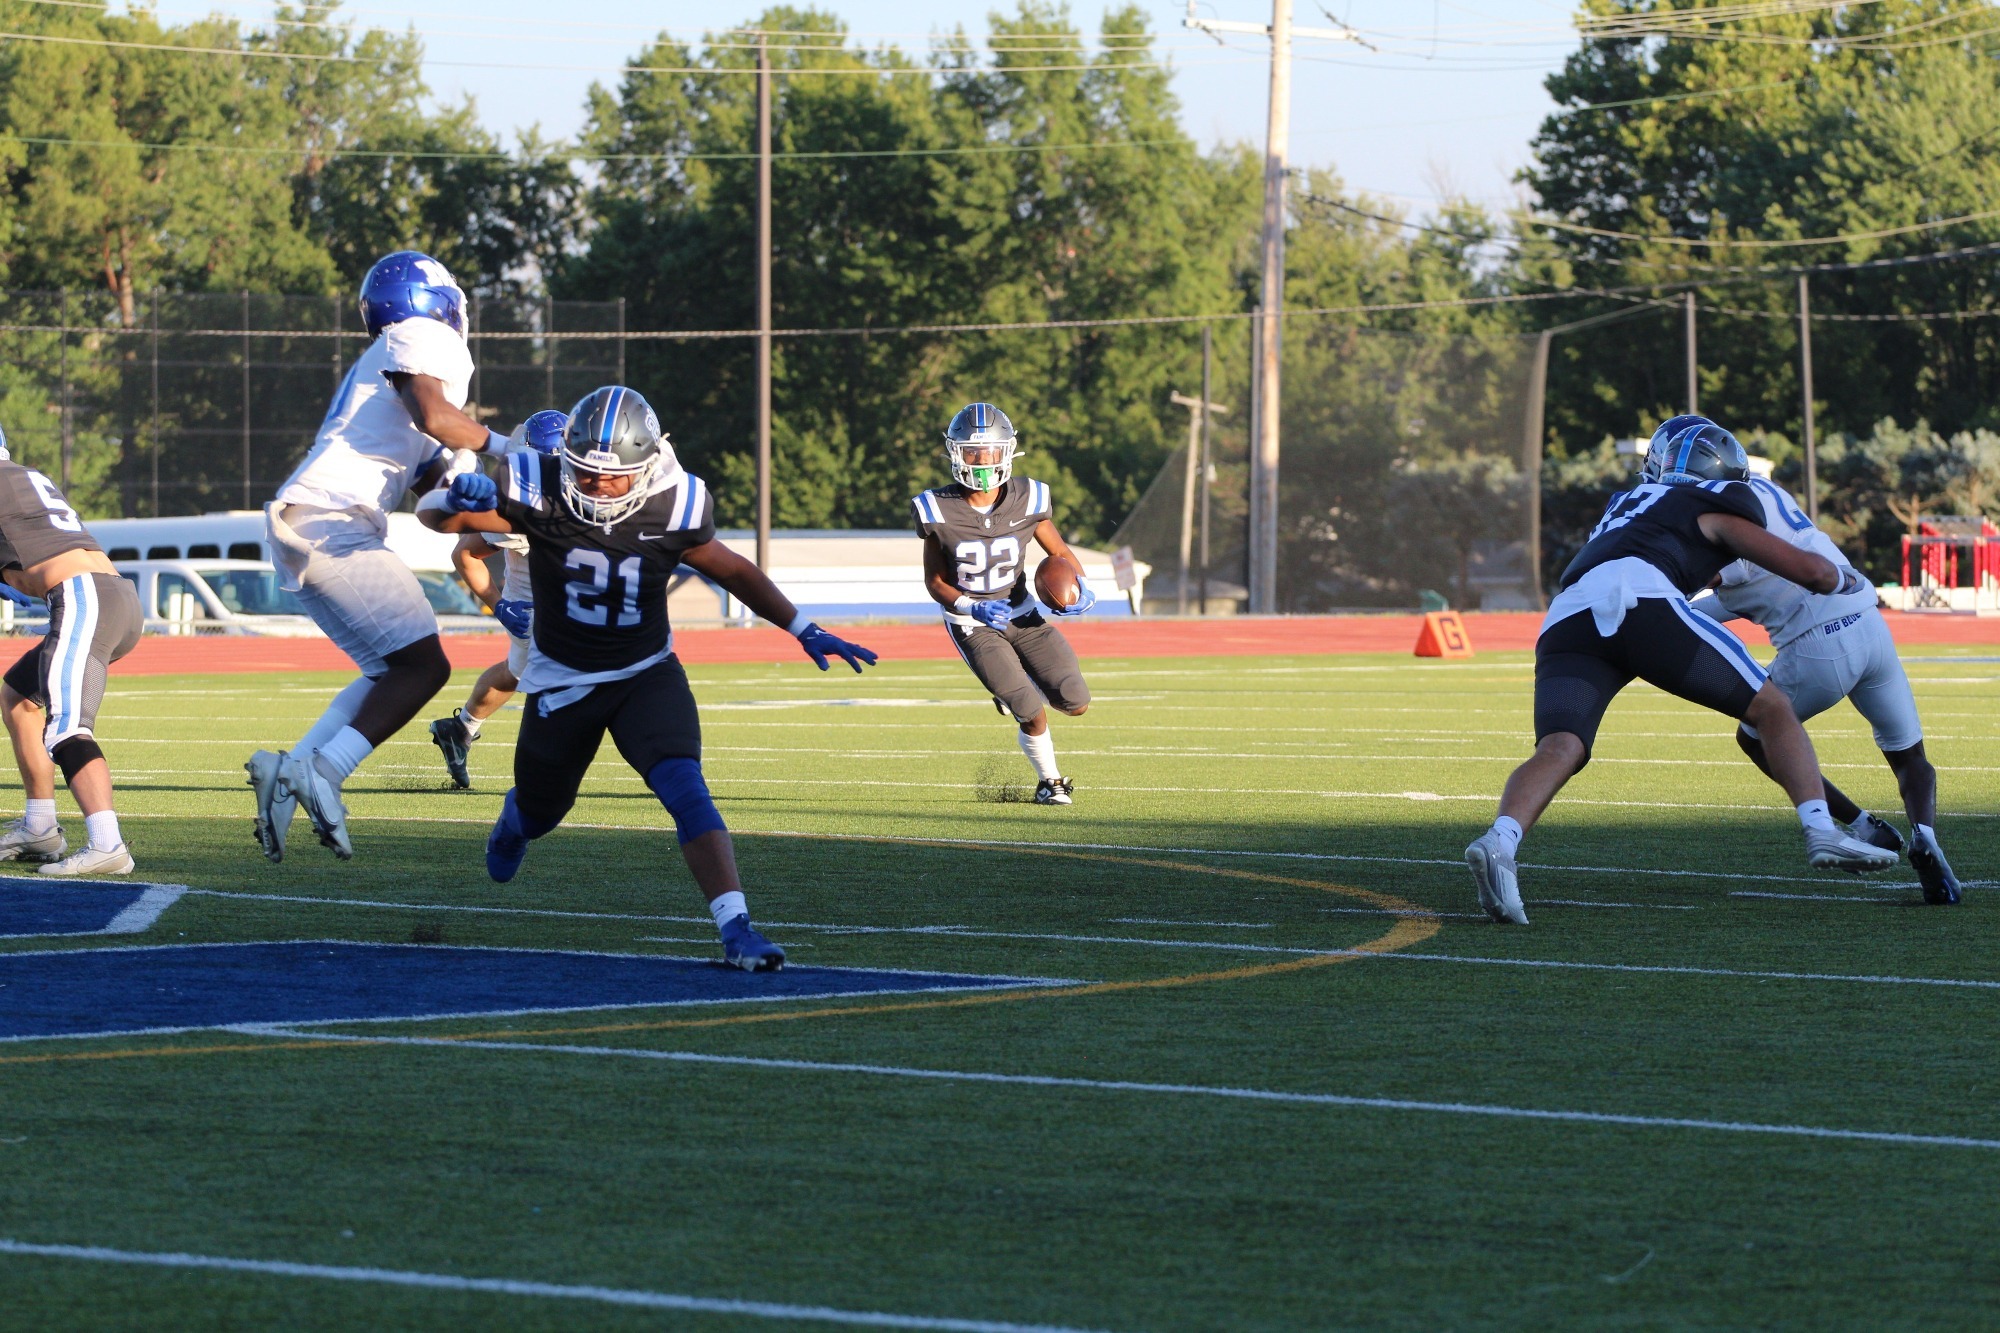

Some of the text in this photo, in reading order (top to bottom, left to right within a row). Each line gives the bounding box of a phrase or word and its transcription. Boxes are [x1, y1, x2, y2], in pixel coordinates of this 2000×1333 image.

[589, 453, 614, 462] FAMILY
[26, 470, 82, 532] 5
[956, 536, 1020, 592] 22
[564, 547, 642, 627] 21
[1439, 617, 1464, 651] G
[1824, 621, 1841, 635] BIG
